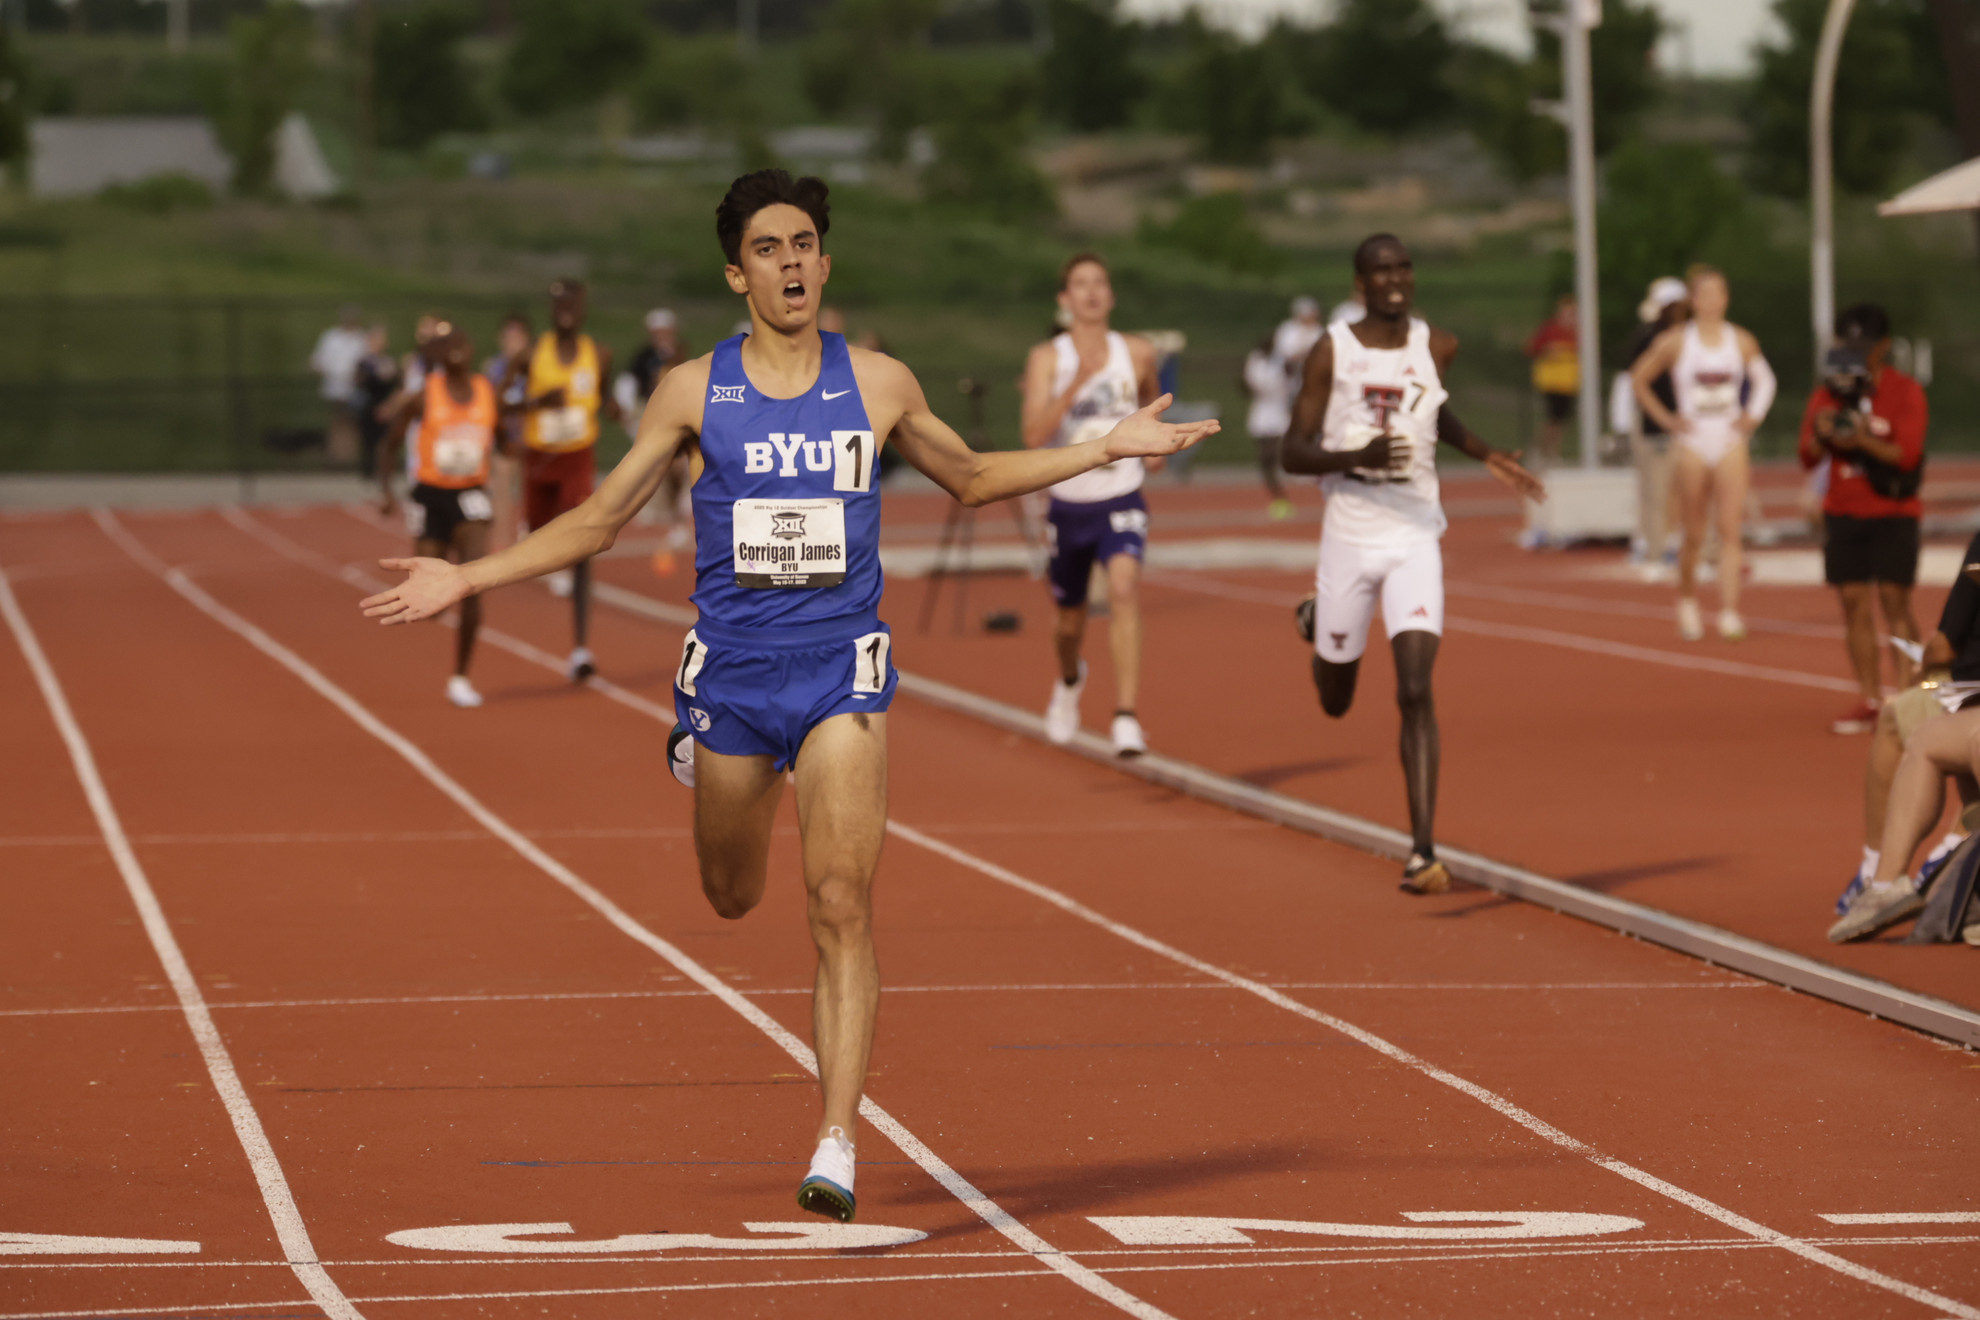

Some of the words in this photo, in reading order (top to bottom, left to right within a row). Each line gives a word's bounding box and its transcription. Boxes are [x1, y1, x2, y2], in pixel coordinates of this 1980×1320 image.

[711, 385, 746, 403] XII
[1410, 381, 1428, 412] 7
[744, 432, 832, 477] BYU
[845, 435, 862, 488] 1
[739, 542, 795, 564] Corrigan
[800, 542, 841, 561] James
[781, 563, 798, 572] BYU
[680, 641, 697, 690] 1
[866, 637, 881, 689] 1
[691, 709, 708, 729] Y
[385, 1222, 929, 1253] 3
[1086, 1211, 1644, 1245] 2
